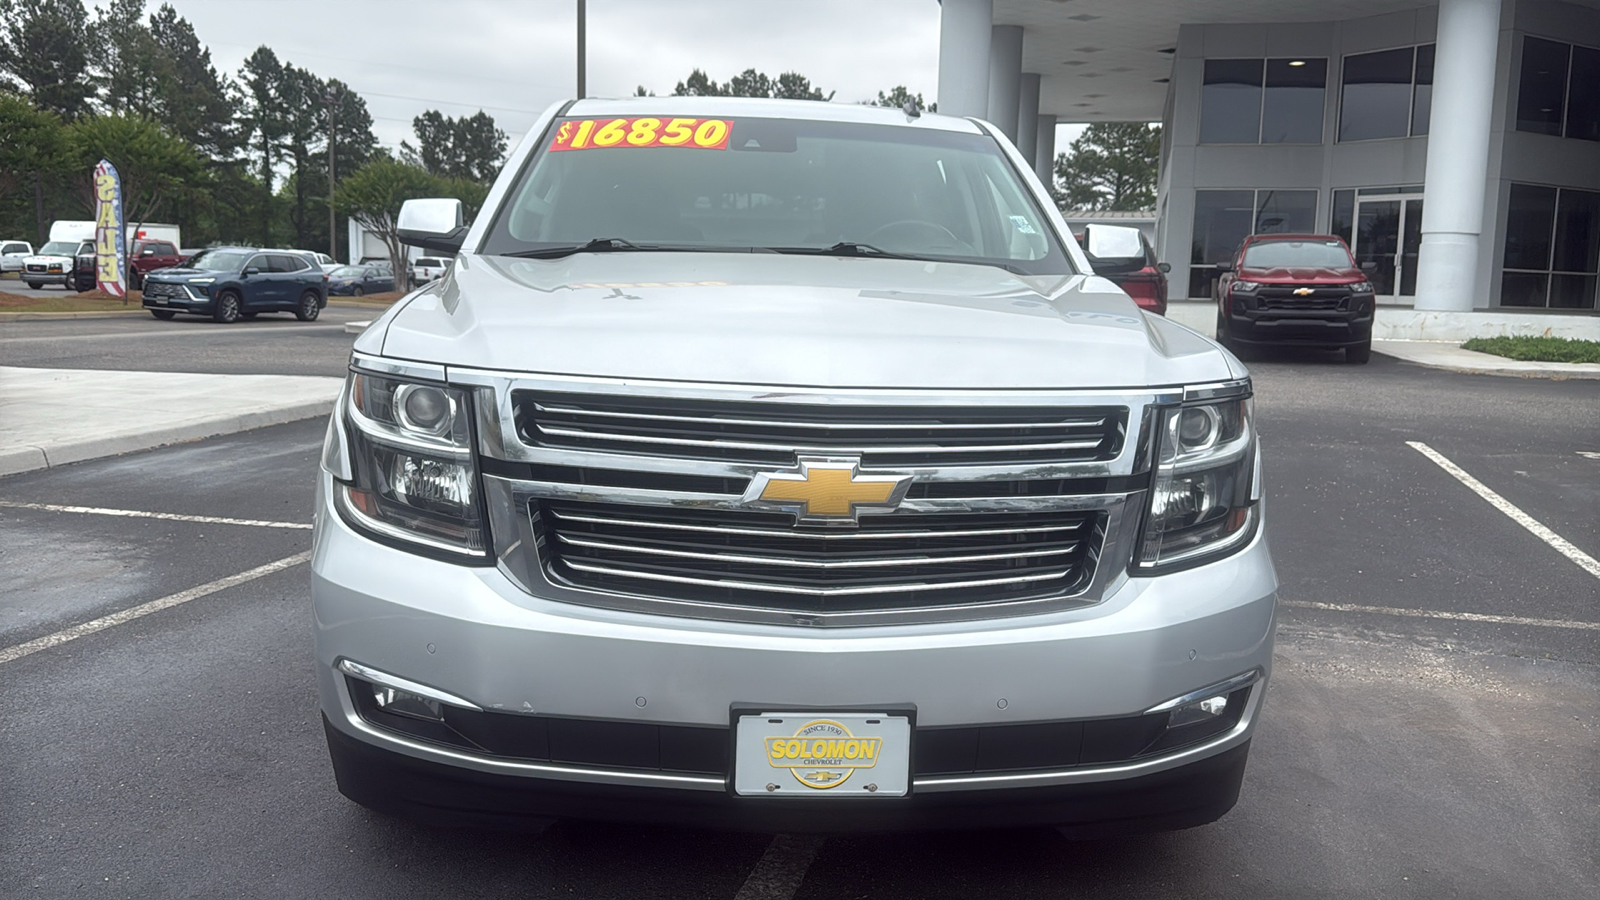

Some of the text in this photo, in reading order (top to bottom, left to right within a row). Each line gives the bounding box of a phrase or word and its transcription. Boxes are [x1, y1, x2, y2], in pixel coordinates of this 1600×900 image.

[557, 118, 728, 148] $16850
[803, 725, 842, 736] SINCE 1930
[771, 740, 875, 759] SOLOMON
